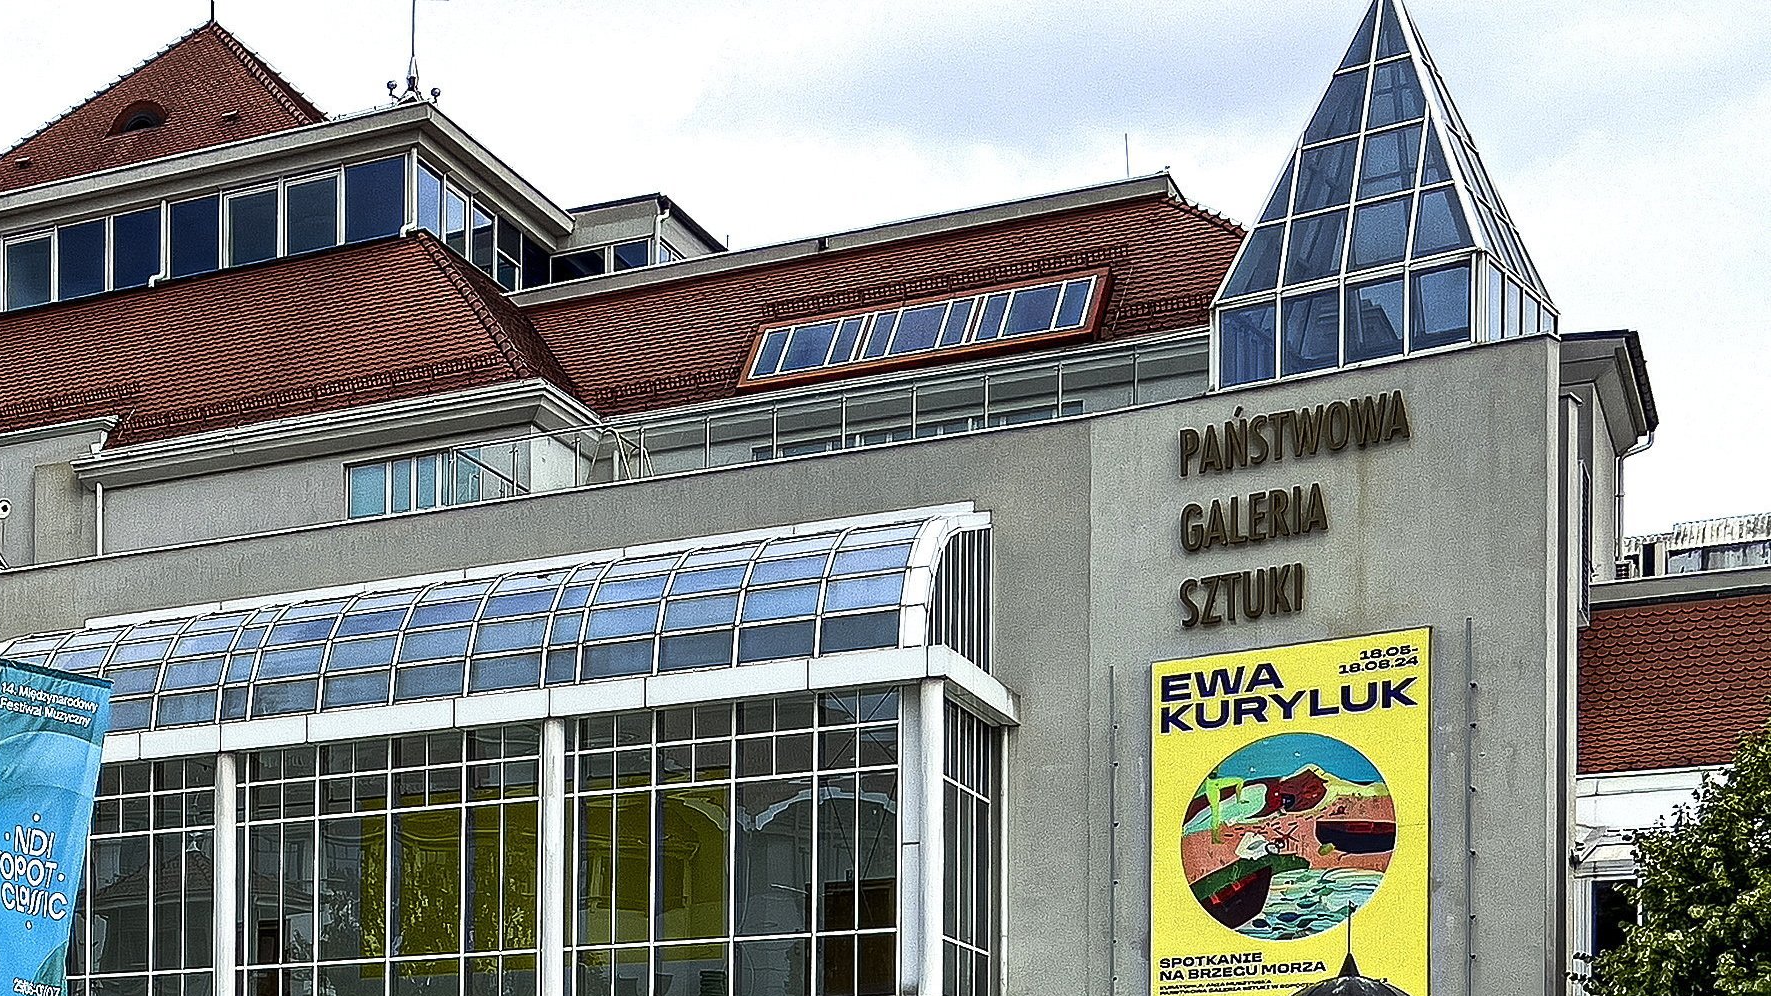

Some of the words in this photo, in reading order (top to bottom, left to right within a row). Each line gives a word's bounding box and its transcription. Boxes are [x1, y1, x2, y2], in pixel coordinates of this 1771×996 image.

[1178, 390, 1411, 477] PAŃSTWOWA
[1179, 482, 1328, 553] GALERIA
[1178, 561, 1305, 628] SZTUKI
[1338, 655, 1419, 674] 18.08.24
[1359, 644, 1418, 661] 18.05-
[1161, 662, 1284, 702] EWA
[0, 697, 43, 717] Festiwal
[44, 706, 92, 728] Muzyczny
[19, 685, 99, 713] Międzynarodowy
[1160, 676, 1418, 734] KURYLUK
[13, 825, 55, 858] NDI
[1159, 951, 1263, 970] SPOTKANIE
[1159, 969, 1185, 982] NA
[1188, 964, 1258, 979] BRZEGU
[1261, 960, 1327, 976] MORZA
